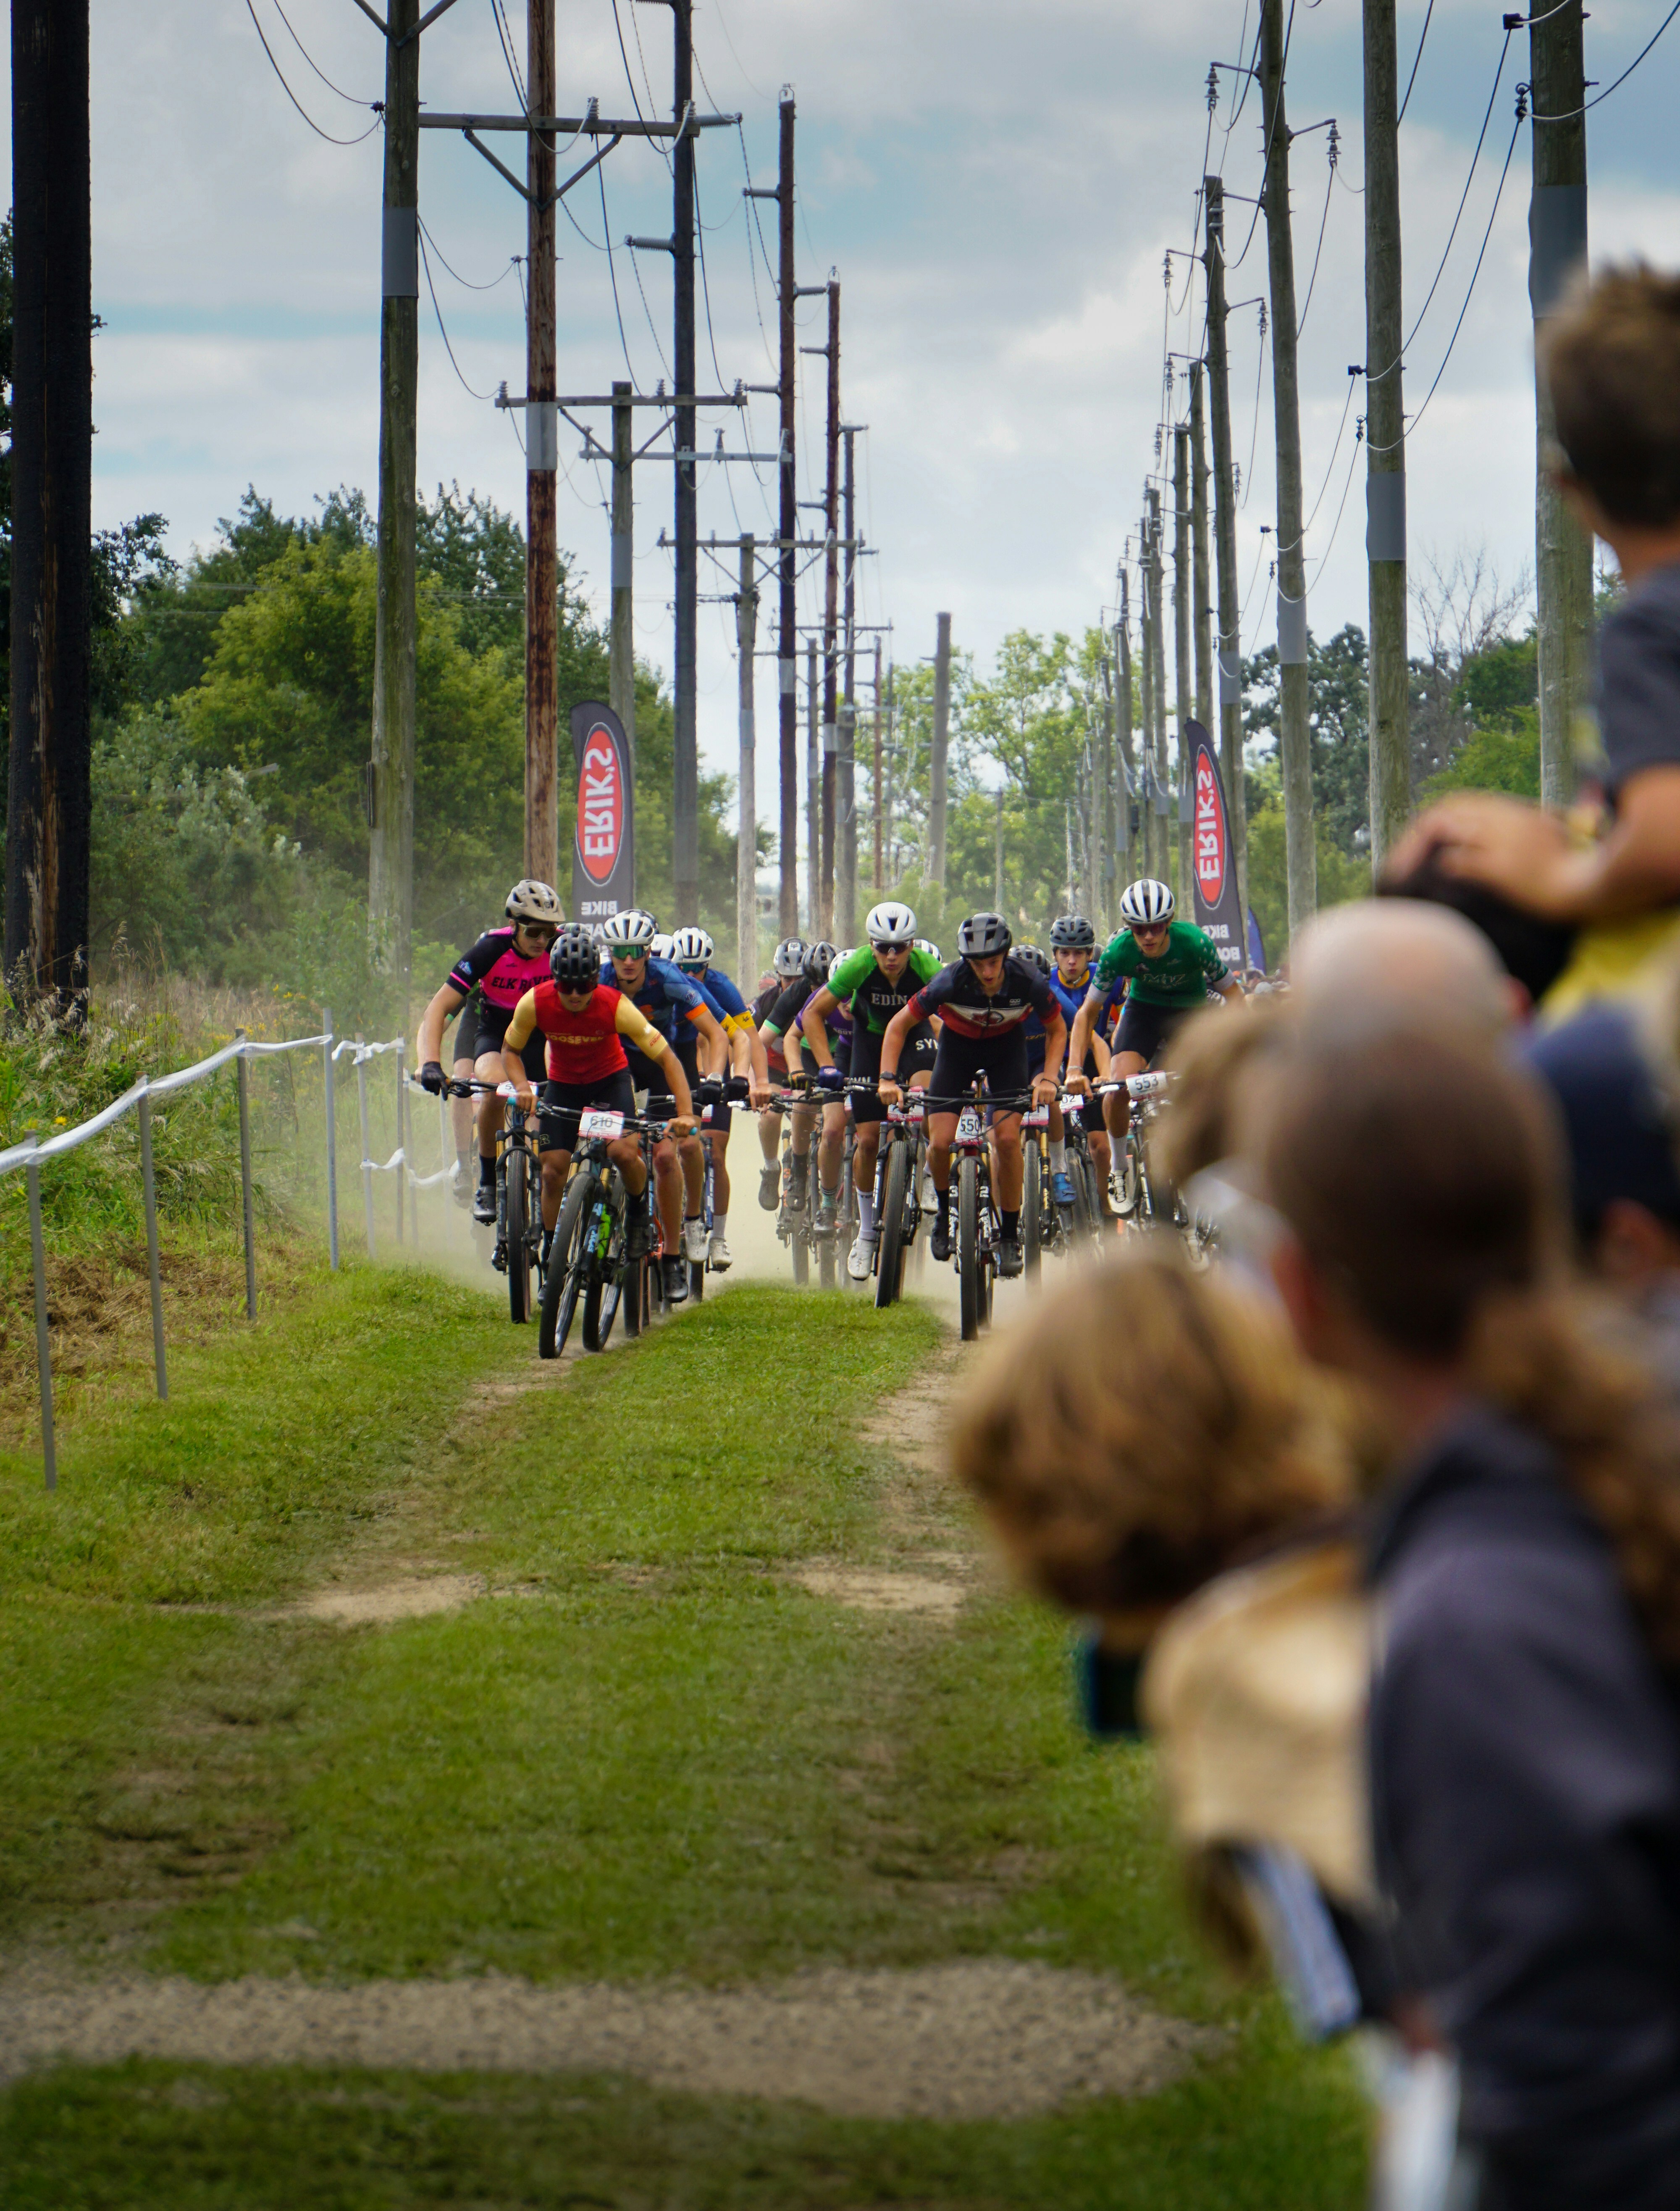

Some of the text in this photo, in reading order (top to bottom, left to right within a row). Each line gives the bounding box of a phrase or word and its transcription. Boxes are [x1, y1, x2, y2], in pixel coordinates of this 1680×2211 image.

[492, 977, 517, 989] ELK
[871, 993, 908, 1005] EDIN
[1135, 1075, 1158, 1090] 553
[1062, 1094, 1076, 1104] 02
[590, 1115, 613, 1128] 610
[539, 1134, 550, 1146] R
[949, 1186, 989, 1197] 3 2
